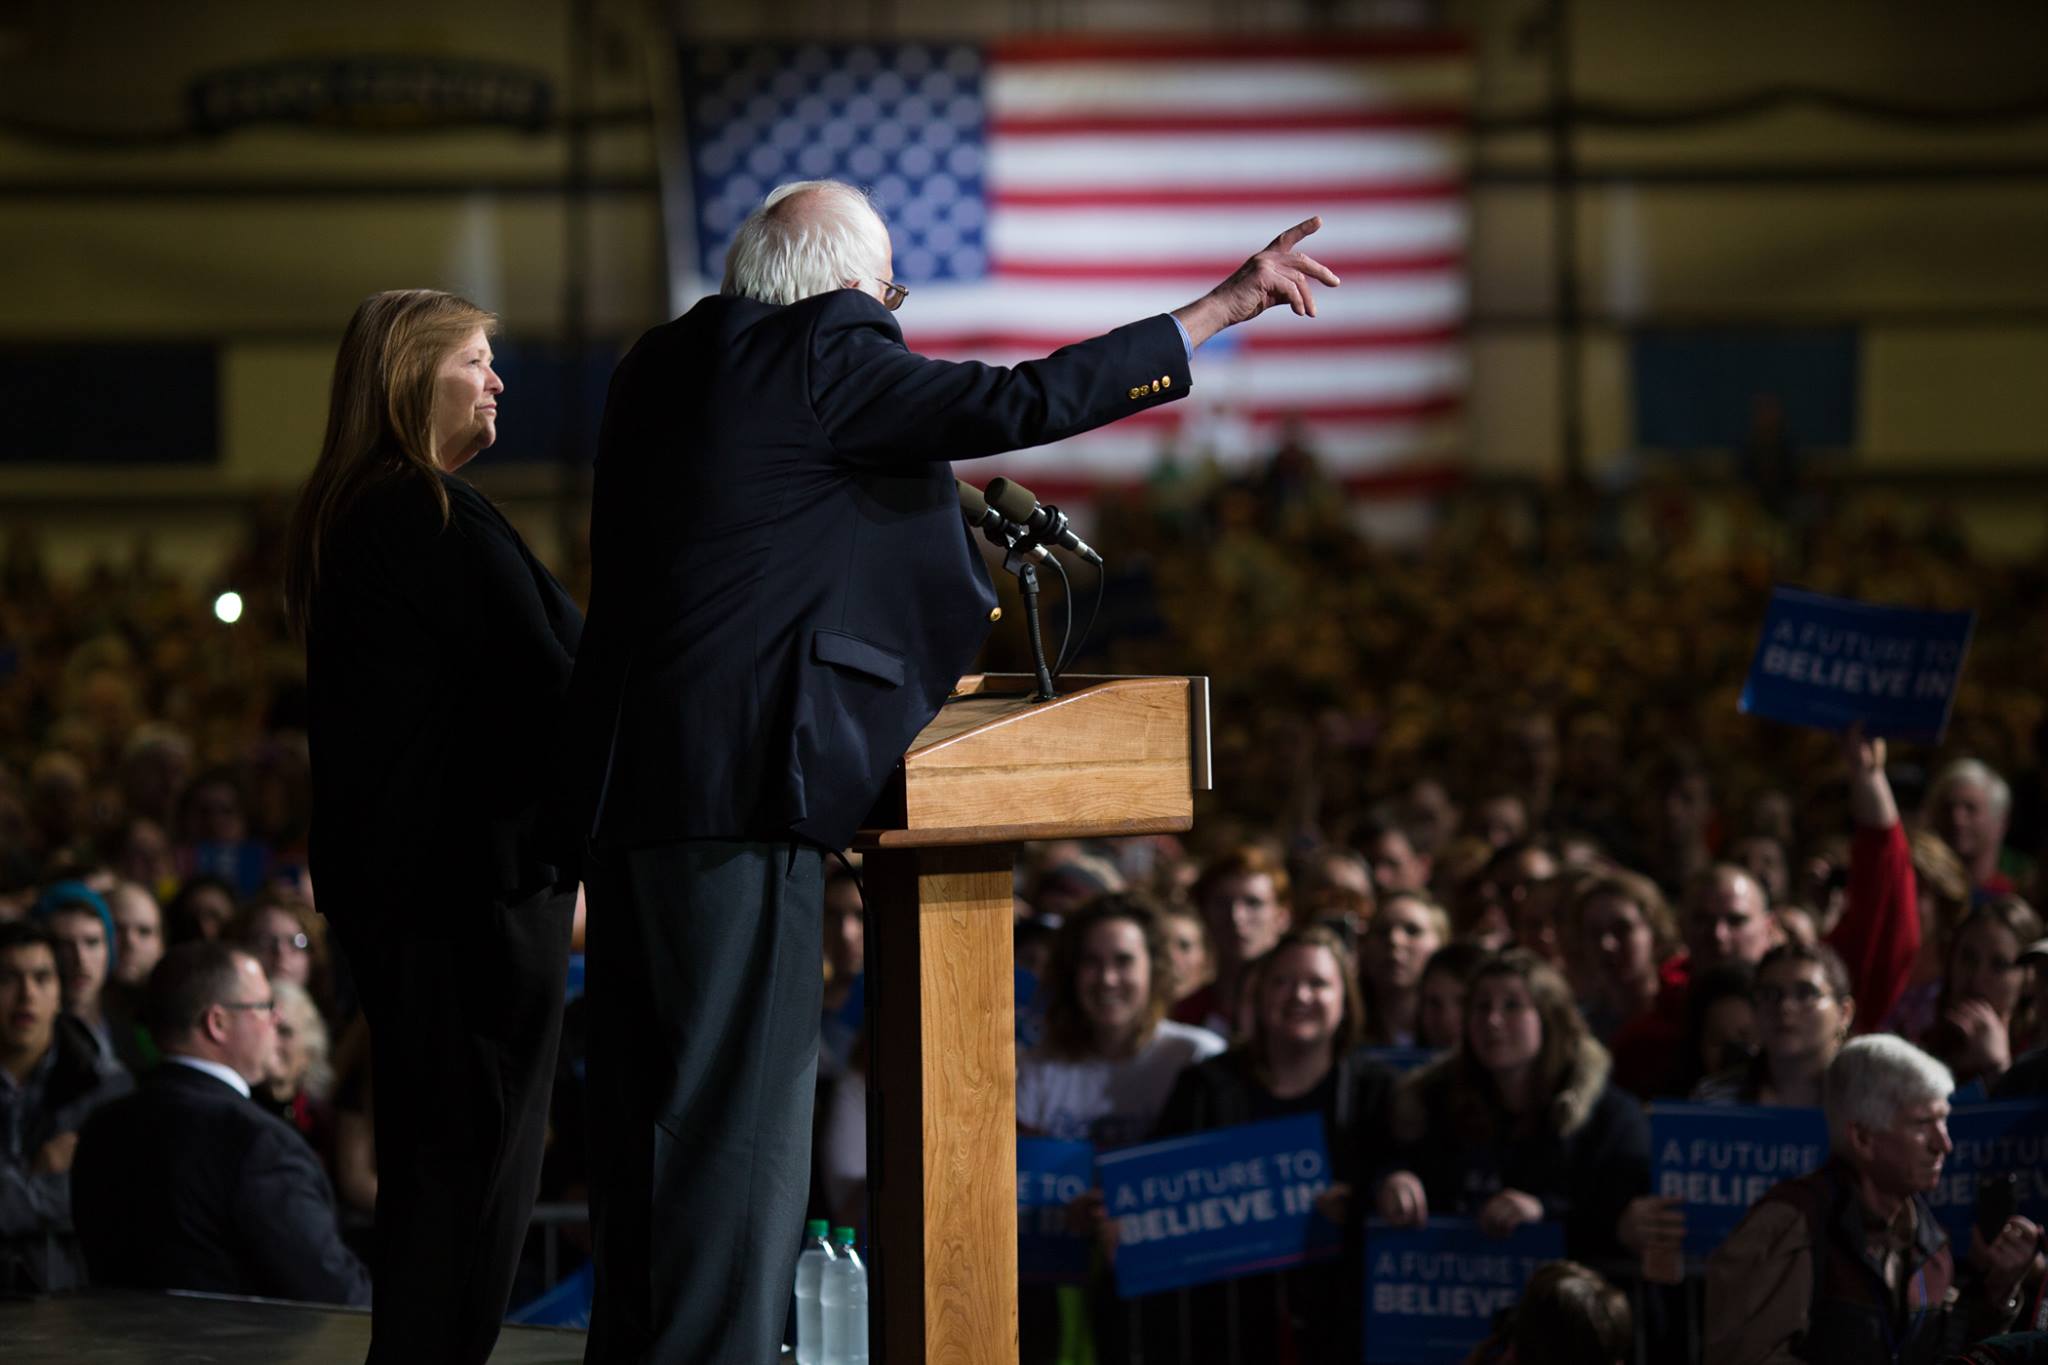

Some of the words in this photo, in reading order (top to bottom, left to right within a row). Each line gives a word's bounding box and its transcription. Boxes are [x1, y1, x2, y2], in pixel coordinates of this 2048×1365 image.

[1773, 617, 1794, 642] A
[1799, 621, 1917, 665] FUTURE
[1922, 639, 1964, 668] TO
[1760, 643, 1912, 698] BELIEVE
[1914, 669, 1950, 699] IN
[1659, 1137, 1685, 1167] A
[1039, 1172, 1088, 1204] TO
[1114, 1182, 1140, 1211] A
[1142, 1154, 1266, 1205] FUTURE
[1273, 1148, 1323, 1181] TO
[1118, 1189, 1278, 1247] BELIEVE
[1373, 1249, 1398, 1278] A
[1400, 1251, 1513, 1284] FUTURE
